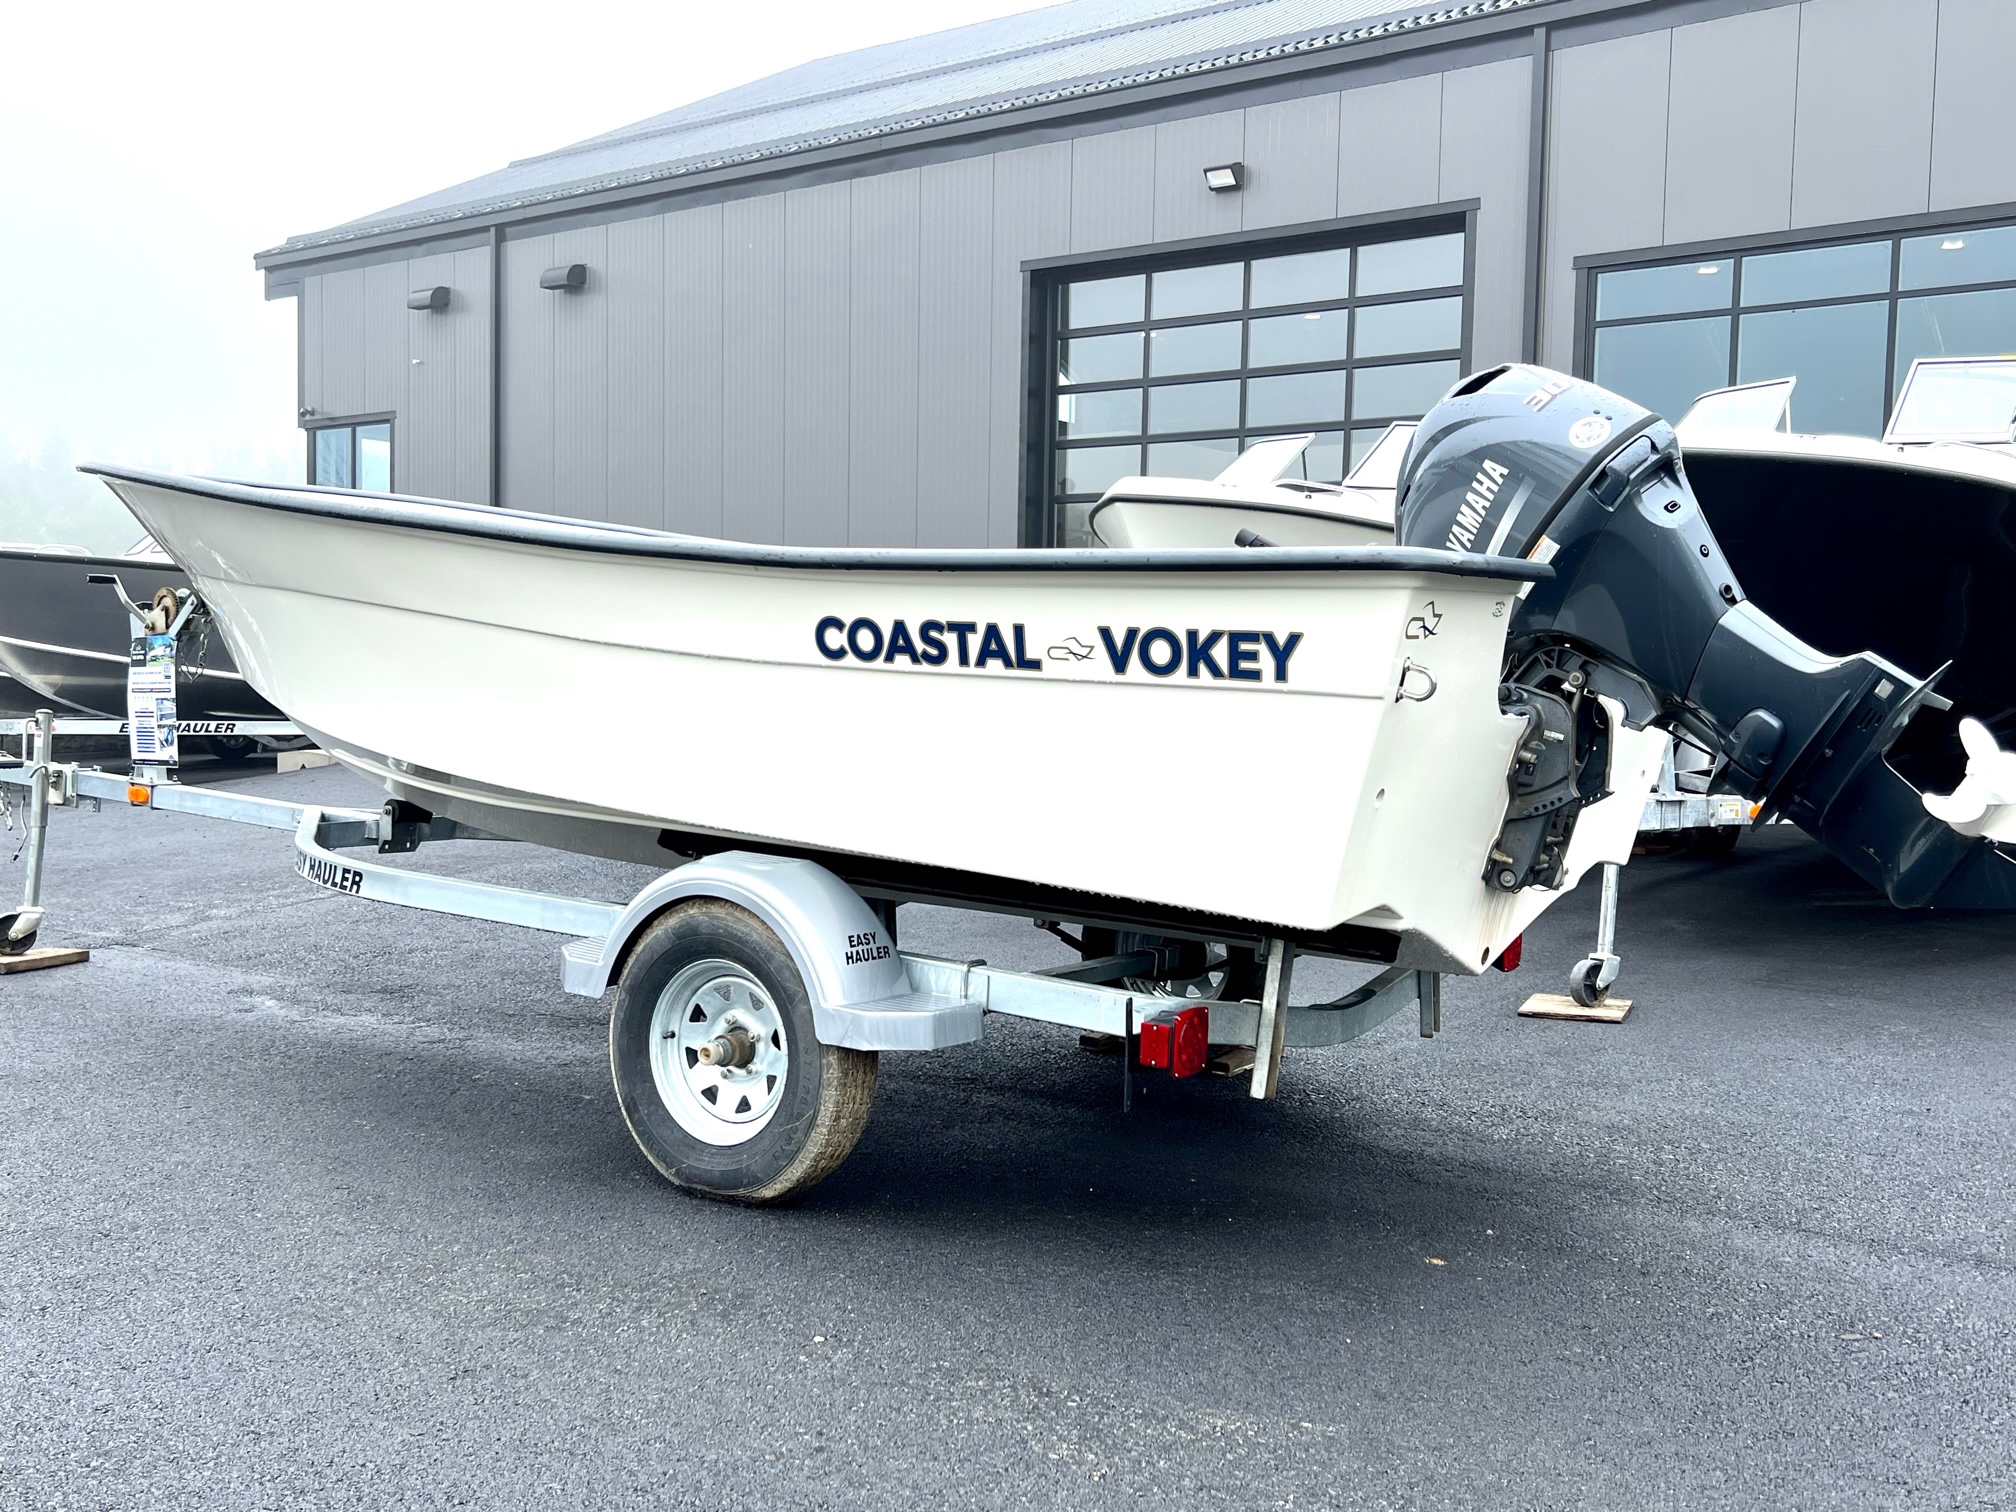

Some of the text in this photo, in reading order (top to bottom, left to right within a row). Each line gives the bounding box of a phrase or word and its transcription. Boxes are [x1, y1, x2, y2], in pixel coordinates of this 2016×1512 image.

[1445, 459, 1510, 553] YAMAHA
[815, 616, 1304, 683] COASTAL VOKEY
[308, 856, 363, 894] HAULER
[845, 946, 891, 965] HAULER
[848, 931, 876, 948] EASY
